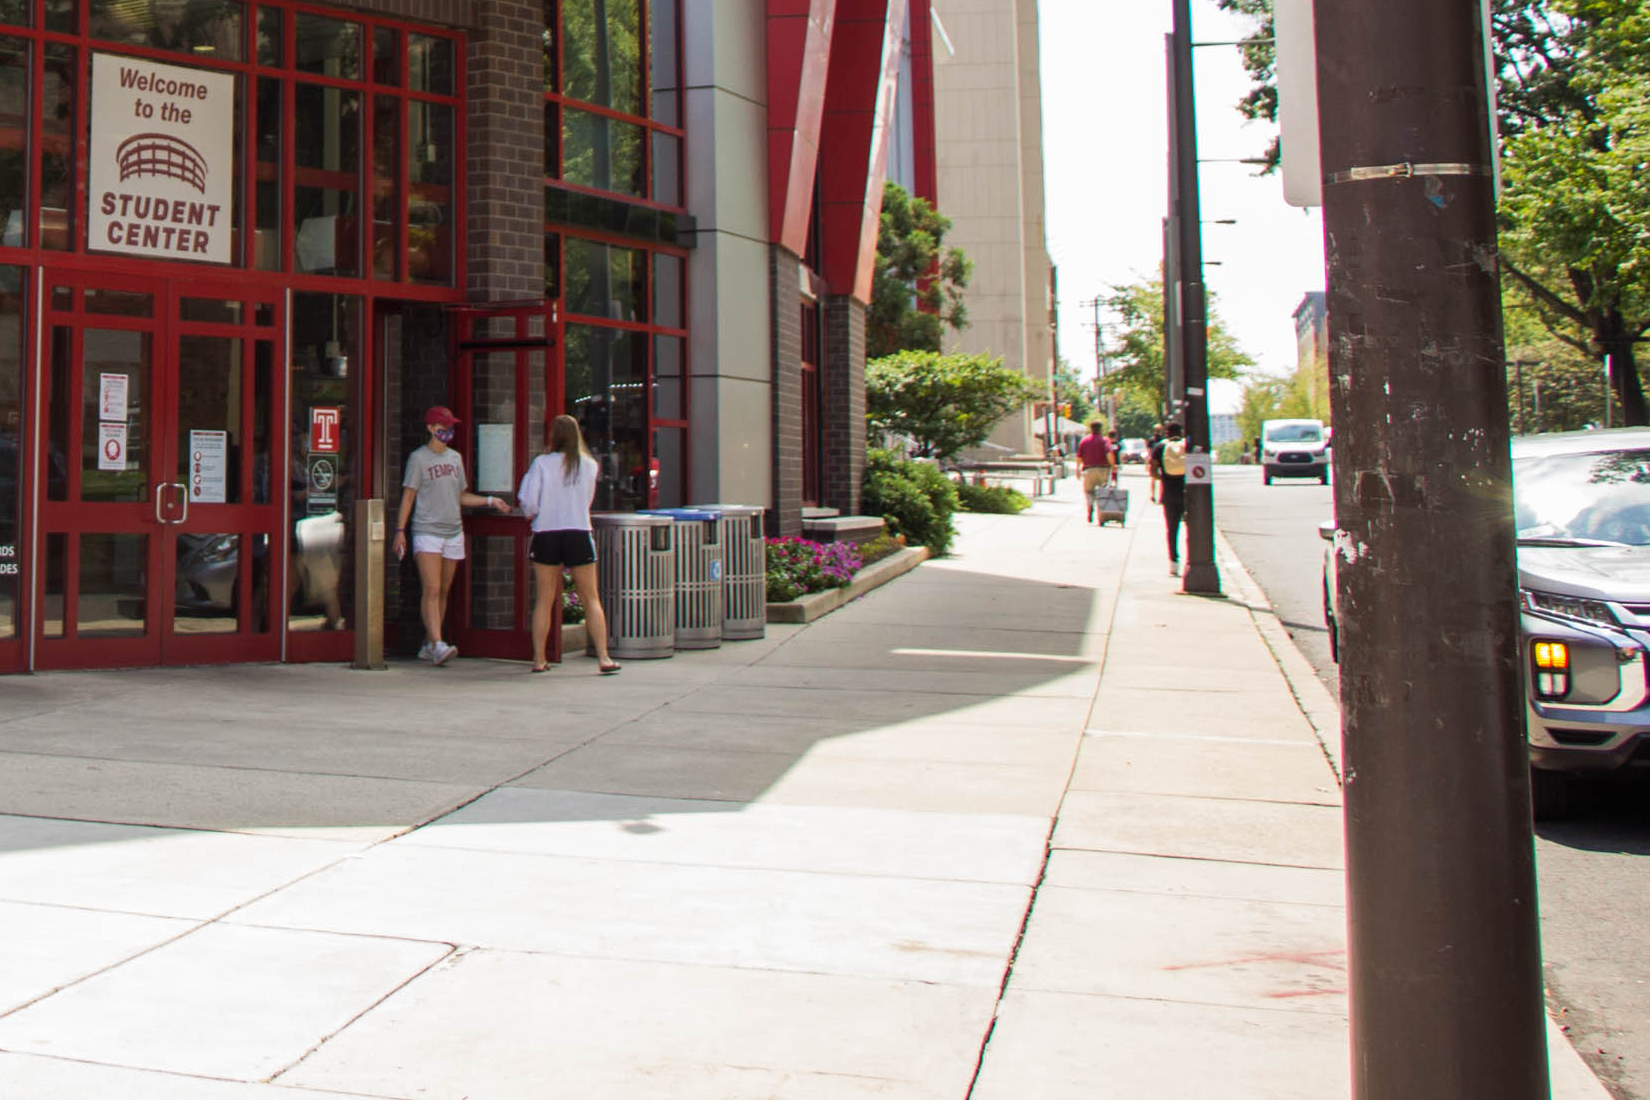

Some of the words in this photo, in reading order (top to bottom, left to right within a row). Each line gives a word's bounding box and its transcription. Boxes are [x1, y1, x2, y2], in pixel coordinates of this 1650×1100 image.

[120, 67, 208, 100] Welcome
[134, 98, 153, 118] to
[161, 102, 191, 124] the
[101, 191, 220, 227] STUDENT
[107, 220, 209, 254] CENTER
